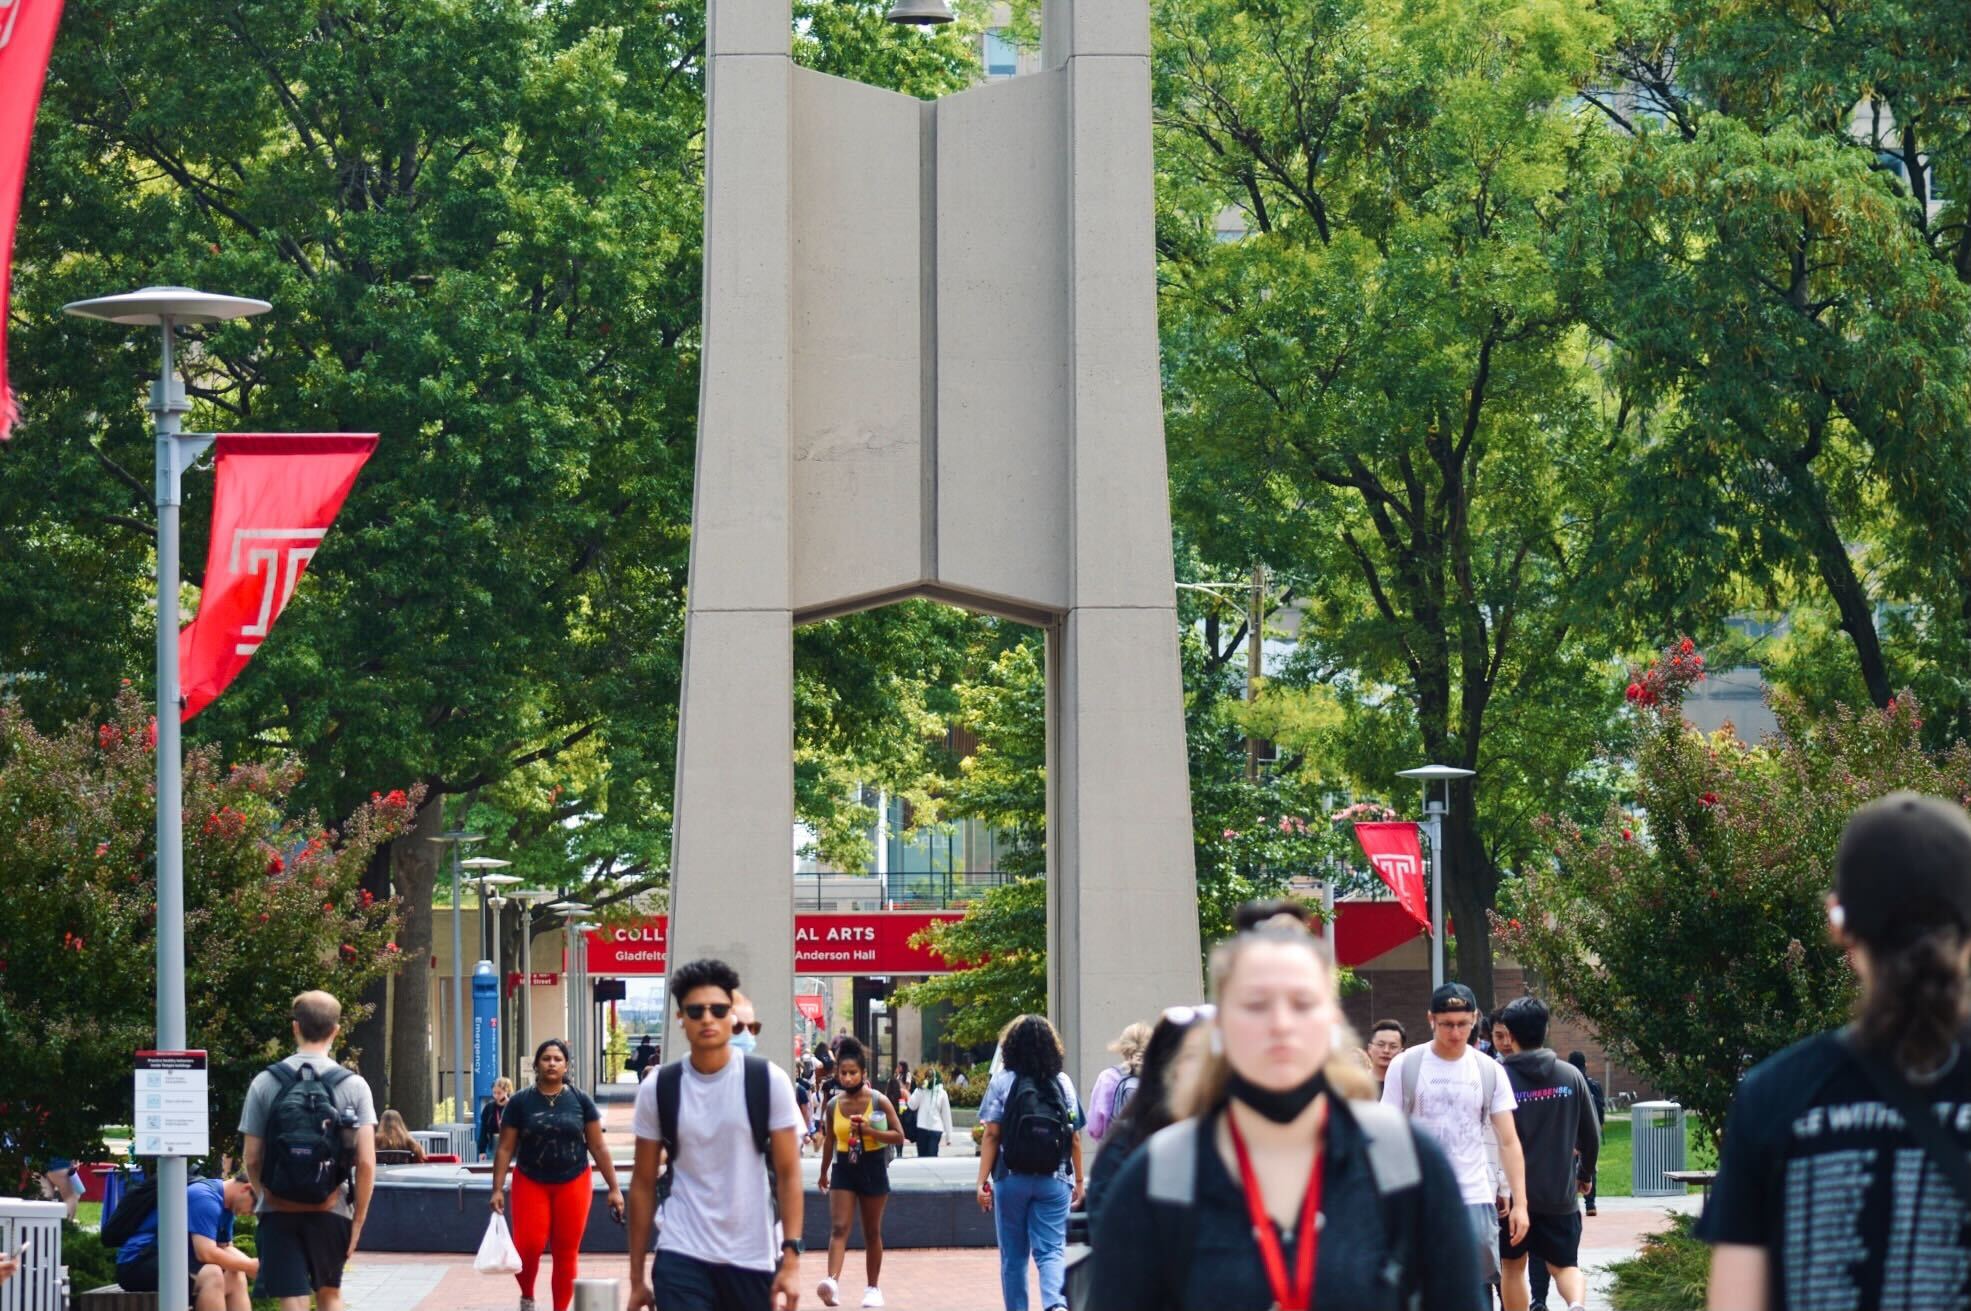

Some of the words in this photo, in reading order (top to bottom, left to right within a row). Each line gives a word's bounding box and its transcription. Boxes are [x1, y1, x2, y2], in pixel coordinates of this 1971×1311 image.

[615, 928, 668, 942] COLL
[826, 927, 875, 942] ARTS
[795, 949, 850, 960] Anderson
[853, 949, 876, 960] Hall
[474, 1016, 482, 1075] Emergency
